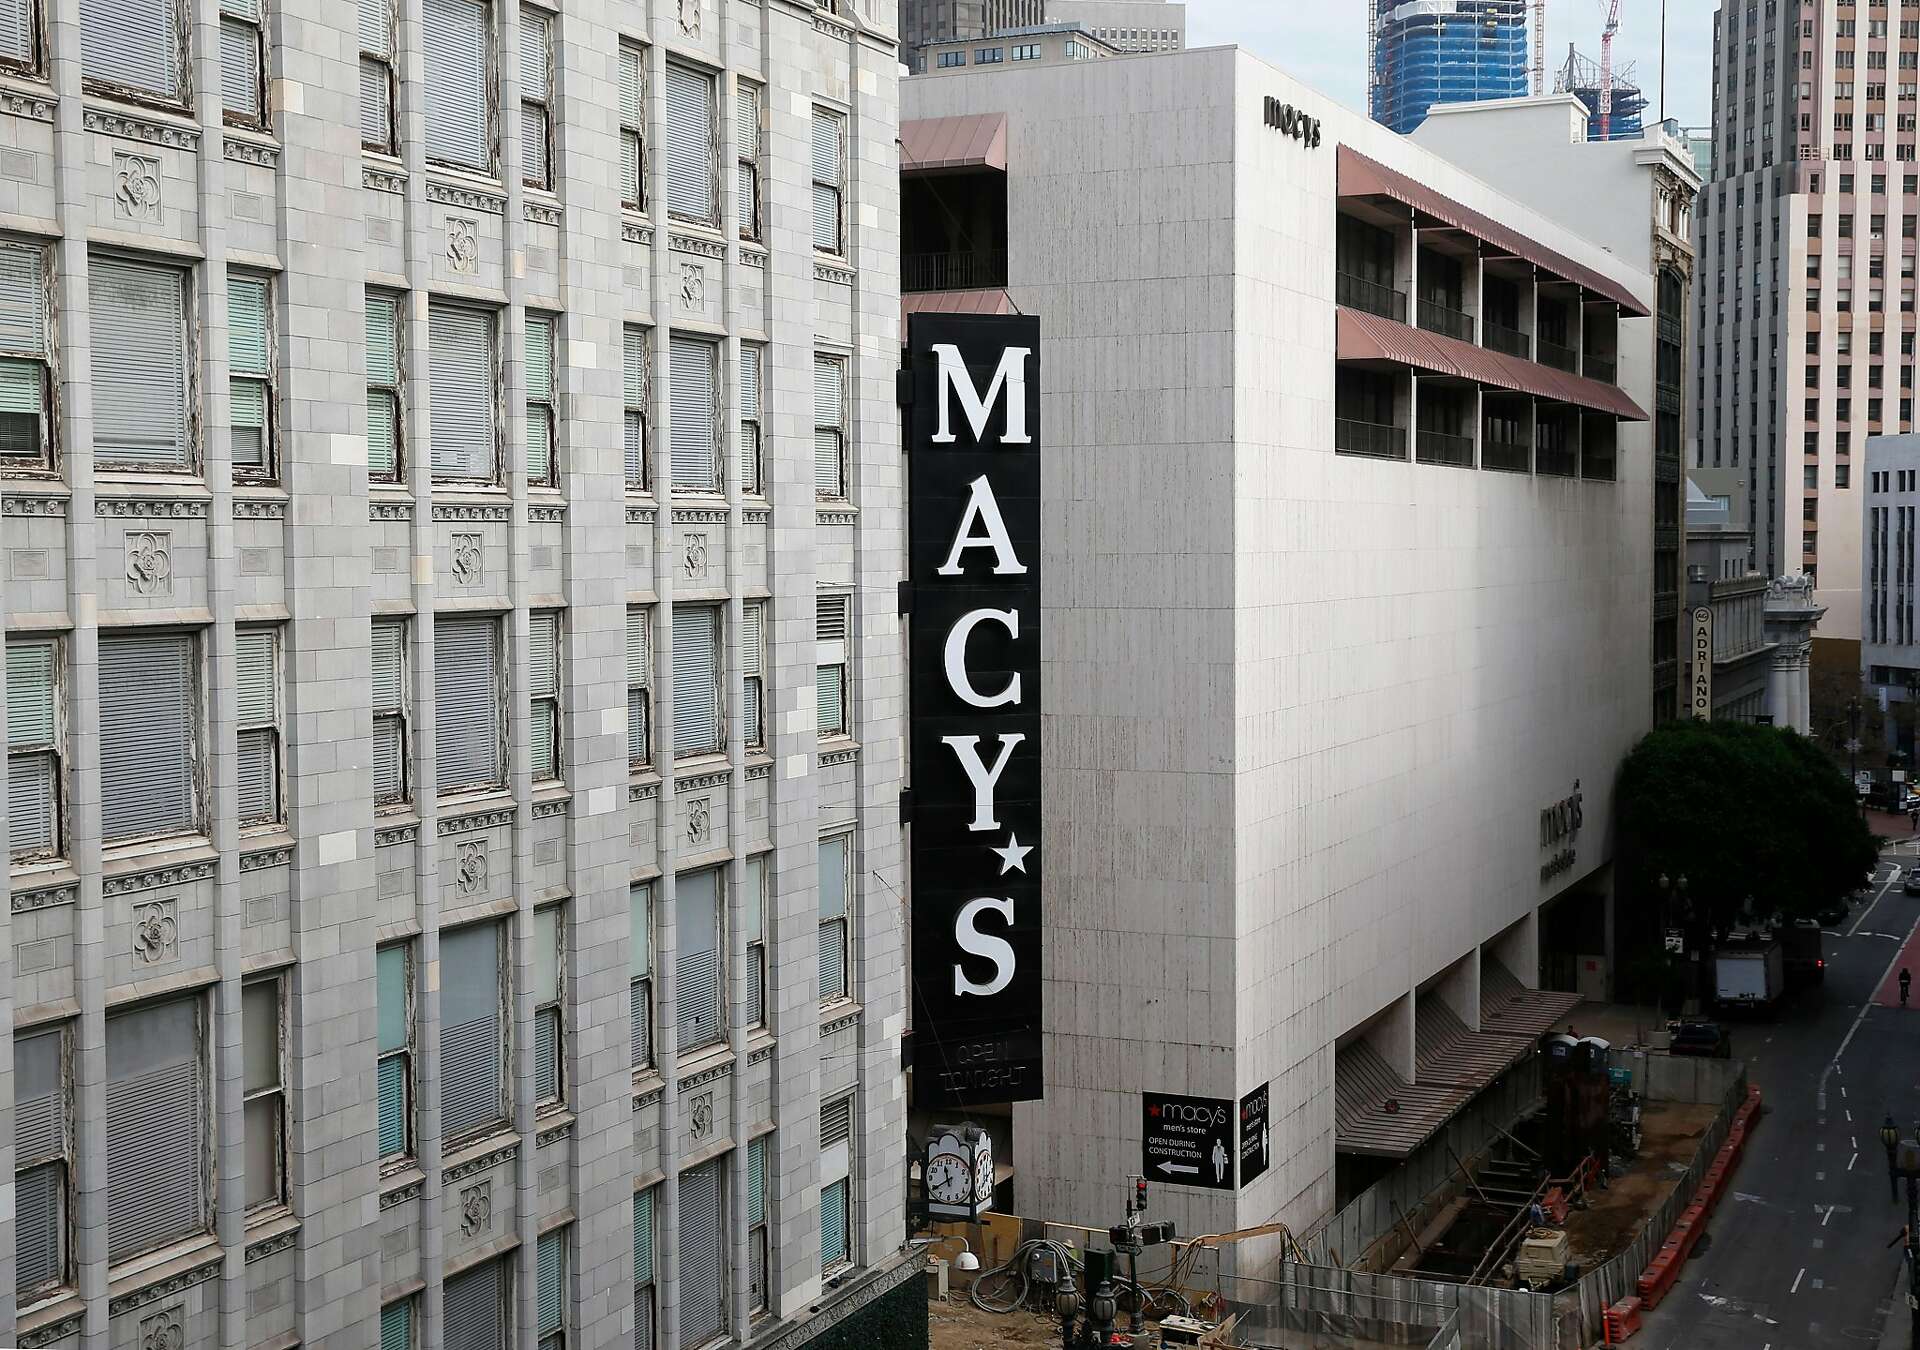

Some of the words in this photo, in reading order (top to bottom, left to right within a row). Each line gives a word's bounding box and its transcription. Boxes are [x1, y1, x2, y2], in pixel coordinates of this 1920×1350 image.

[1696, 627, 1707, 708] ADRIANO
[1163, 1124, 1186, 1133] men's
[1187, 1127, 1207, 1135] store
[1148, 1136, 1168, 1146] OPEN
[1168, 1138, 1196, 1149] DURING
[1148, 1146, 1202, 1159] CONSTRUCTION
